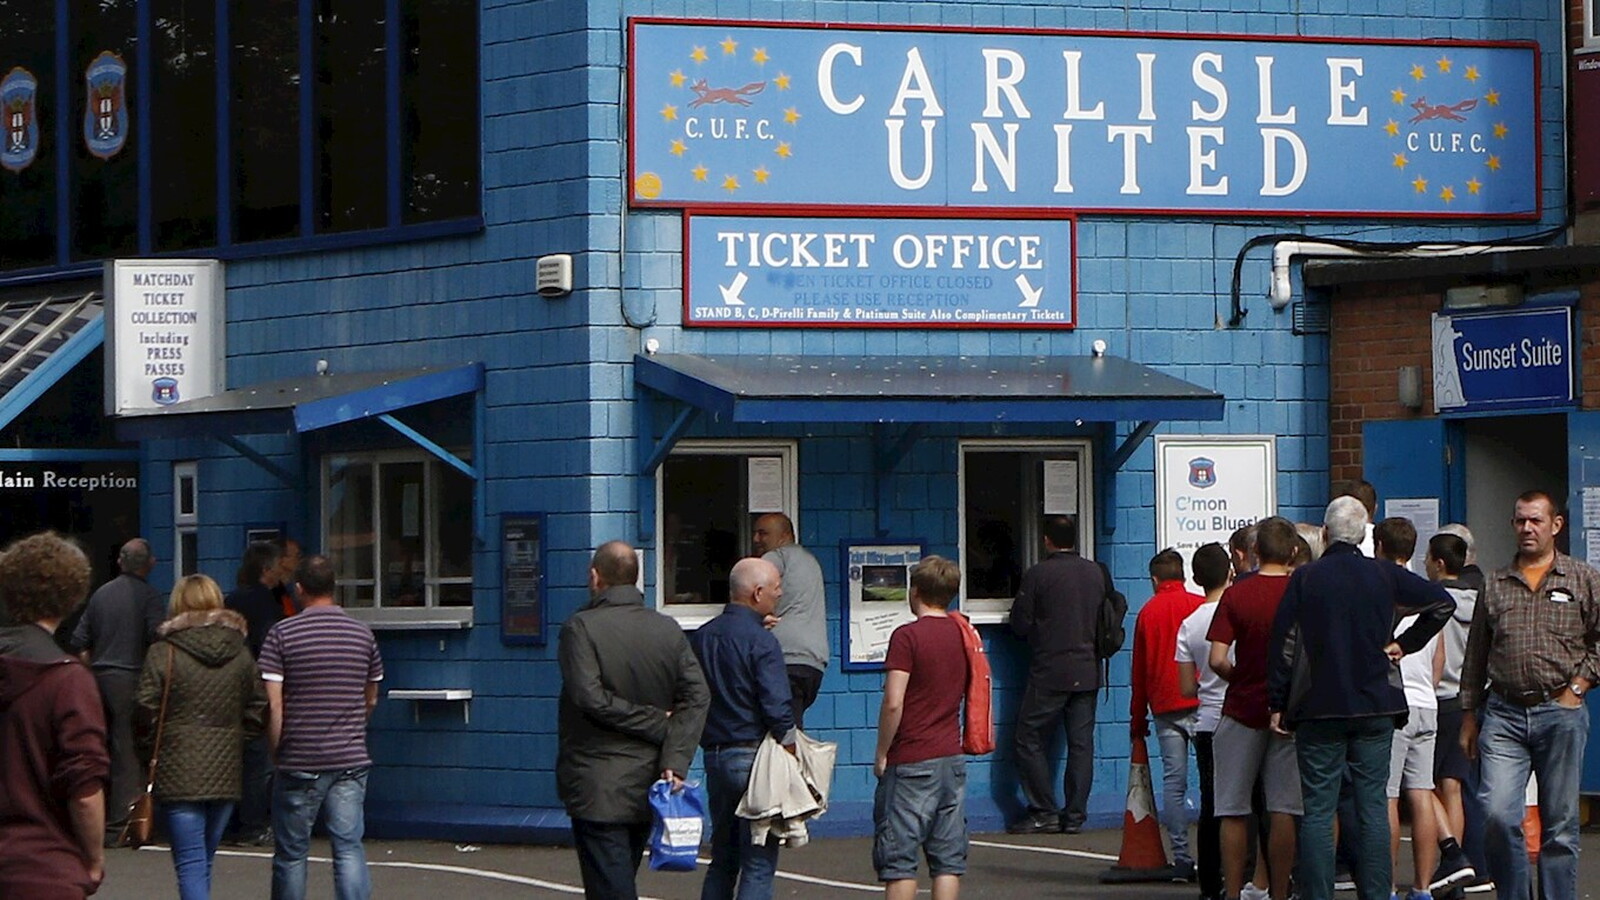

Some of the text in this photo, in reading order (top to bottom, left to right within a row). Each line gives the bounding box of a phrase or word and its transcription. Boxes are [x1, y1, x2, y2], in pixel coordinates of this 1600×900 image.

[818, 43, 1368, 126] CARLISLE
[884, 120, 1308, 196] UNITED
[717, 232, 1043, 270] TICKET OFFICE
[133, 274, 195, 286] MATCHDAY
[822, 274, 874, 289] TICKET
[880, 275, 933, 289] OFFICE
[936, 276, 993, 290] CLOSED
[143, 293, 185, 305] TICKET
[794, 292, 969, 307] PLEASE USE RECEPTION
[131, 312, 198, 324] COLLECTION
[695, 307, 1064, 322] STAND B, C, D-Pirelli Family & Platinum Suite Also Complimentary Tickets
[140, 332, 189, 346] Including
[147, 348, 182, 360] PRESS
[1463, 337, 1562, 371] Sunset Suite
[145, 364, 185, 376] PASSES
[43, 471, 137, 491] Reception
[1176, 496, 1227, 511] C'mon
[1176, 517, 1206, 531] You
